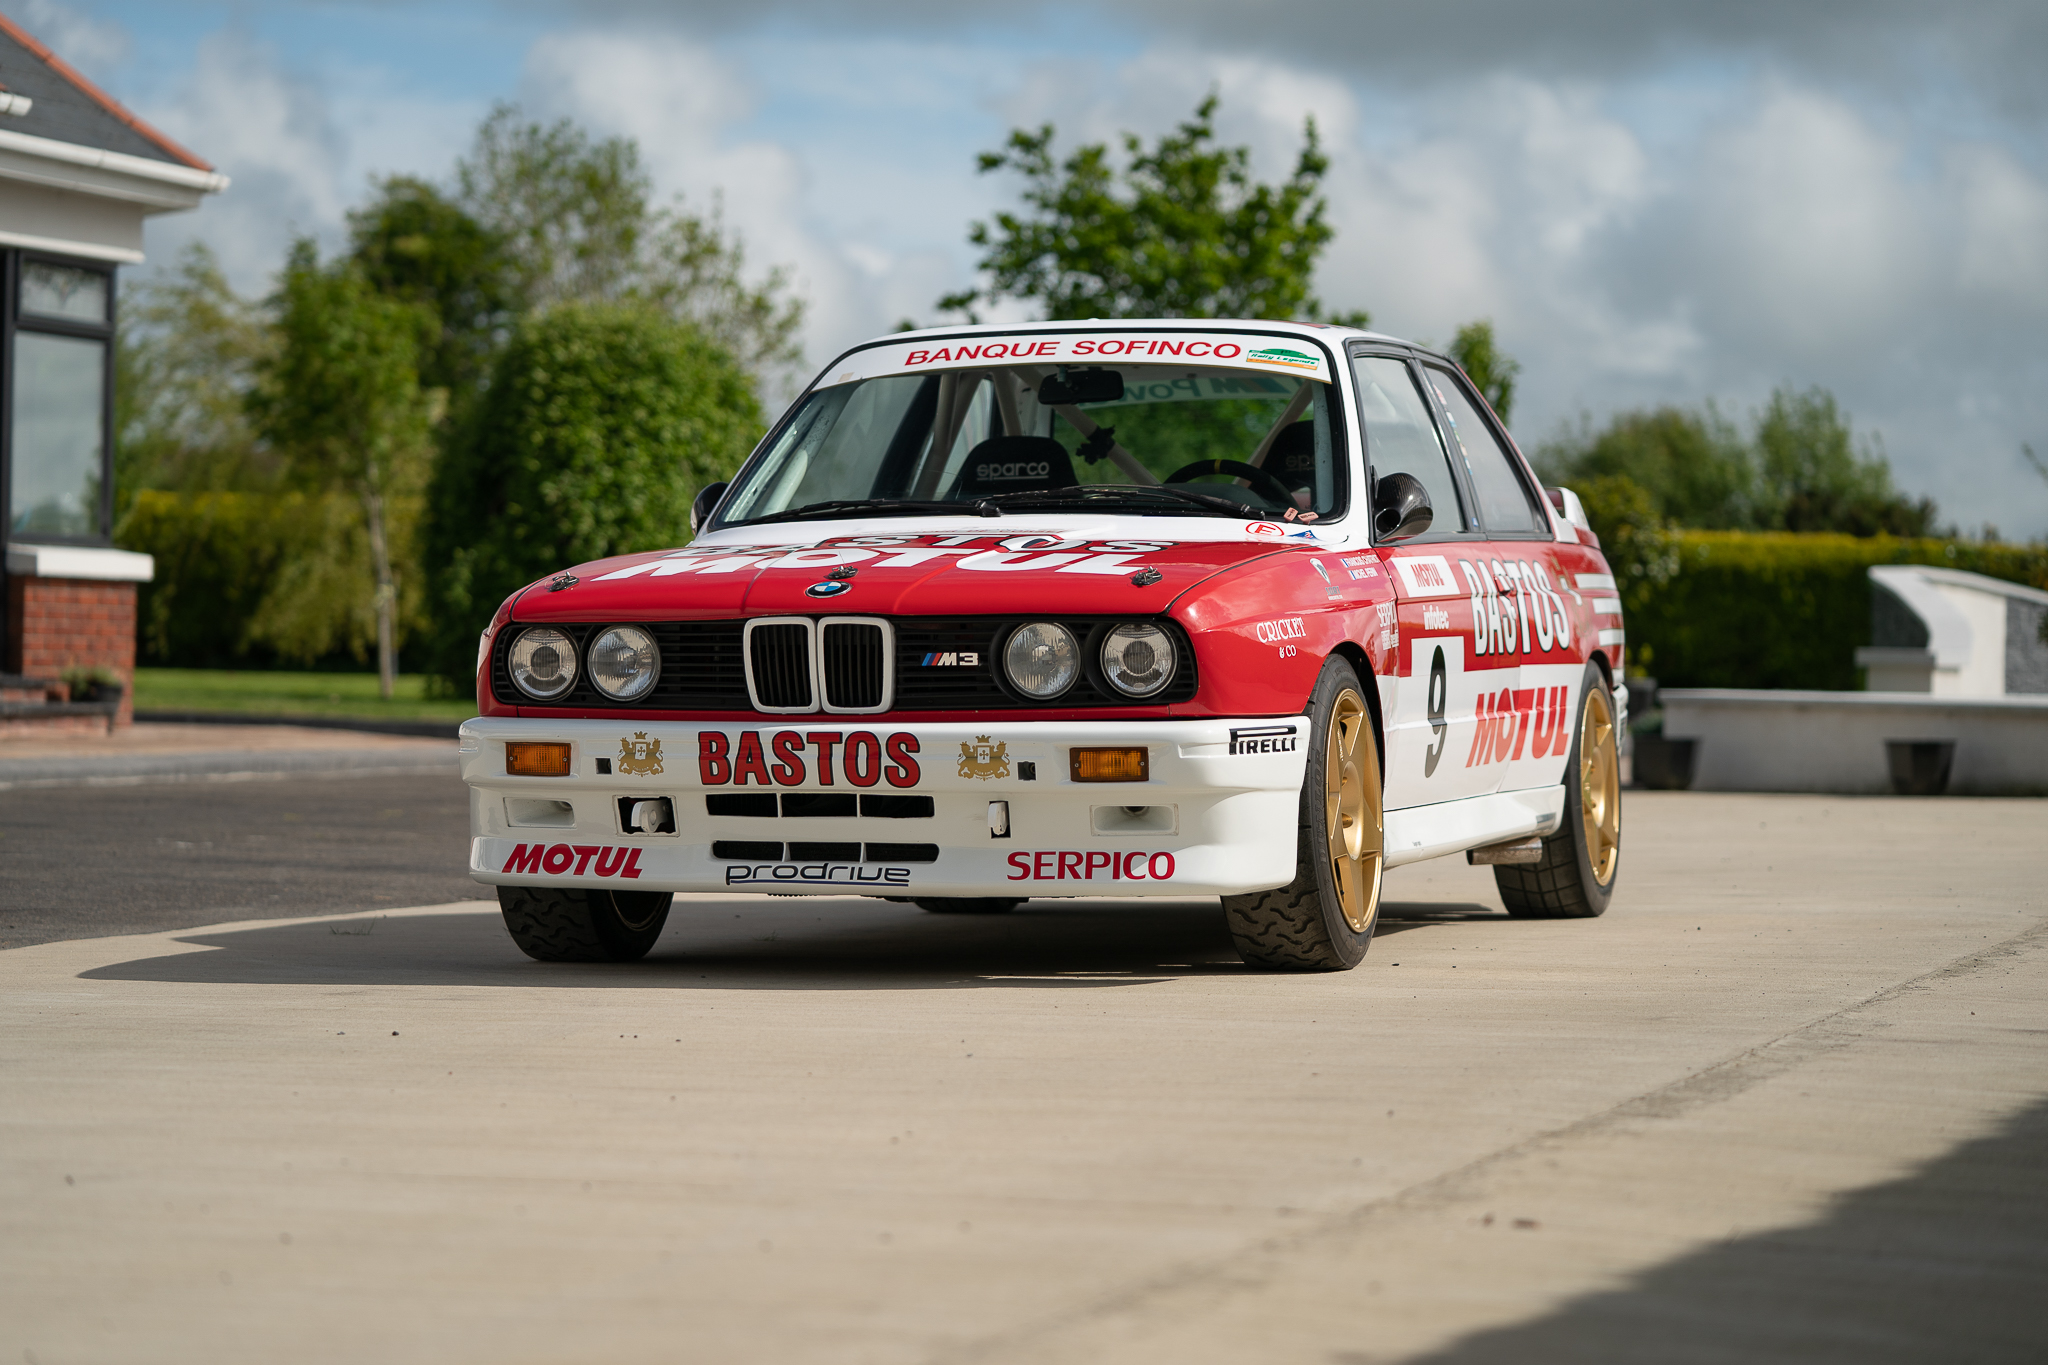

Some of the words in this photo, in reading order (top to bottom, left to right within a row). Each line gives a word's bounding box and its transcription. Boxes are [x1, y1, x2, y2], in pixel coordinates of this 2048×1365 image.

[904, 341, 1061, 366] BANQUE
[1071, 340, 1241, 359] SOFINCO
[976, 462, 1050, 481] sparco
[1253, 523, 1276, 535] E
[590, 547, 1146, 582] MOTUL
[1410, 563, 1444, 588] MOTUL
[1423, 605, 1450, 630] infotec
[1458, 558, 1570, 656] BASTOS
[1256, 616, 1307, 643] CRICKET
[937, 652, 979, 666] M3
[1285, 645, 1297, 658] CO
[1424, 645, 1448, 778] 9
[1229, 725, 1297, 755] PIRELLI
[1465, 685, 1569, 768] MOTUL
[698, 730, 922, 788] BASTOS
[501, 843, 643, 879] MOTUL
[725, 862, 911, 885] prodrive
[1006, 851, 1176, 881] SERPICO
